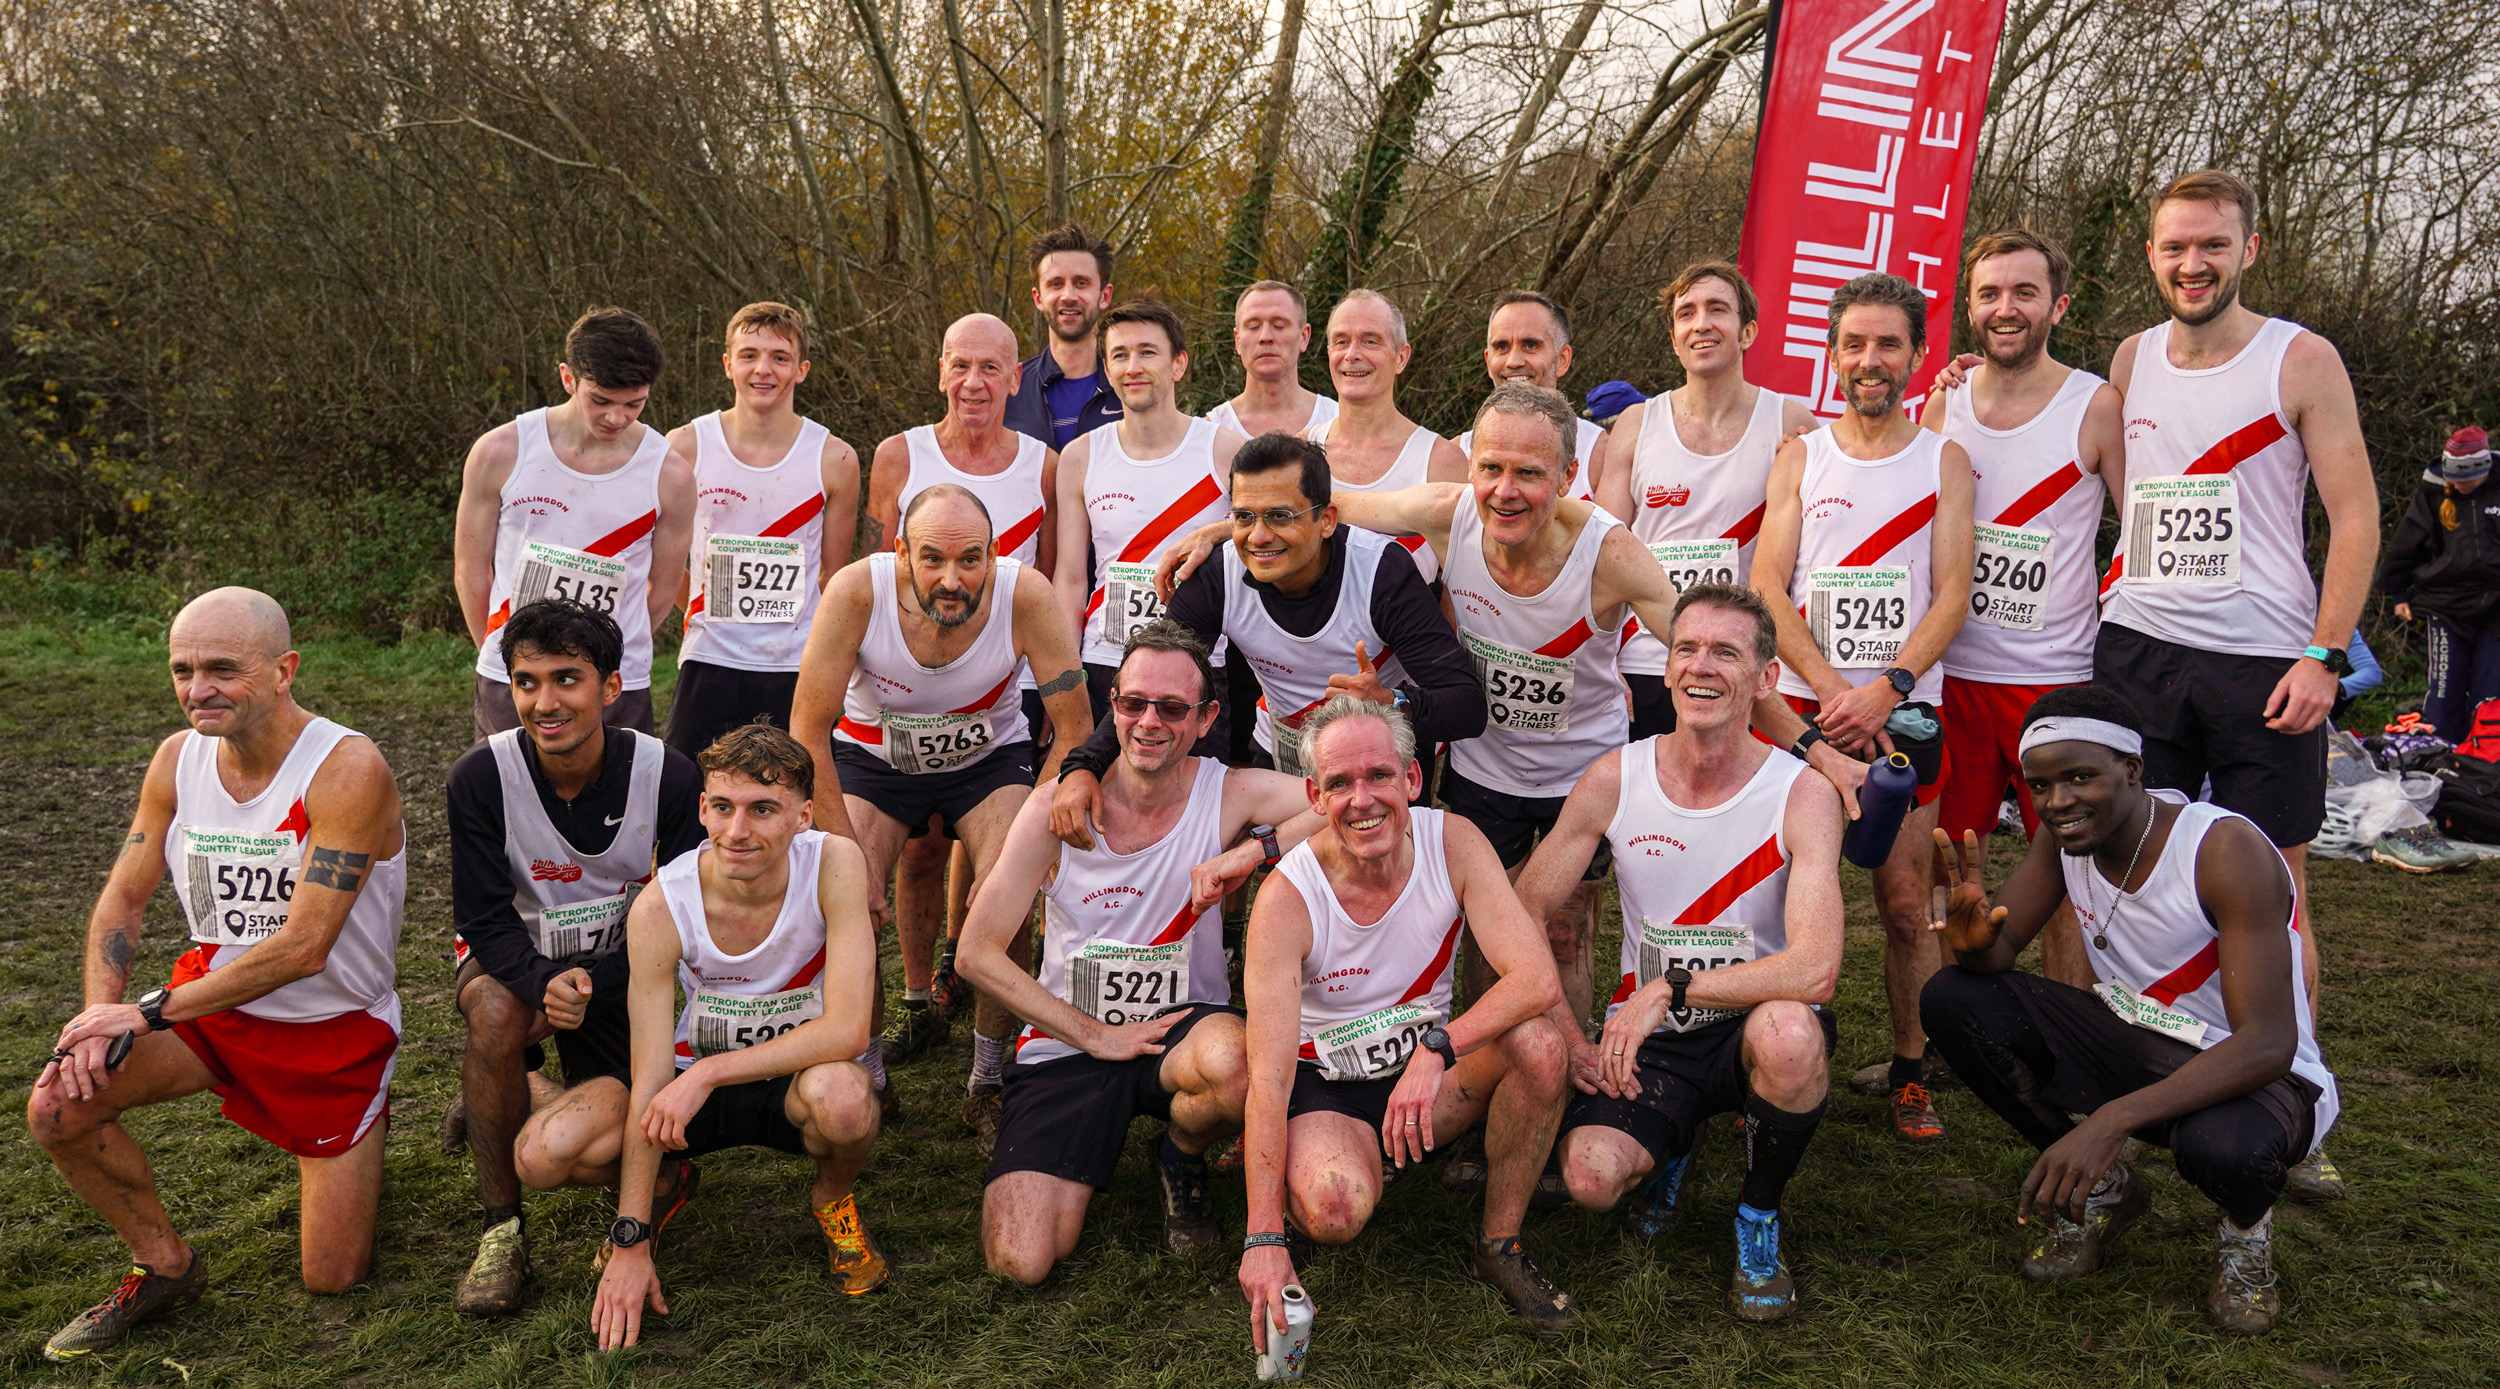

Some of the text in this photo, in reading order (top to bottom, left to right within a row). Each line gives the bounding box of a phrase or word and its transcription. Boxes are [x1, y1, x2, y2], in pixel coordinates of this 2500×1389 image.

[2134, 480, 2231, 492] METROPOLITAN CROSS
[698, 487, 748, 502] HILLINGDON
[1088, 492, 1136, 510] HILLINGDON
[2141, 489, 2220, 499] COUNTRY LEAGUE
[512, 496, 569, 512] HILLINGDON
[1804, 497, 1853, 518] HILLINGDON
[530, 508, 548, 516] A.C.
[1816, 510, 1832, 519] A.C.
[2156, 507, 2233, 542] 5235
[1974, 525, 2051, 544] OPOLITAN CROSS
[710, 538, 799, 550] METROPOLITAN CROSS
[1650, 543, 1732, 555] TROPOLITAN CROSS
[1974, 534, 2040, 551] NTRY LEAGUE
[529, 543, 626, 572] METROPOLITAN CROSS
[758, 548, 790, 556] LEAGUE
[1656, 552, 1722, 562] UNTRY LEAGUE
[536, 553, 615, 578] COUNTRY LEAGUE
[2178, 554, 2229, 566] START
[738, 562, 800, 591] 5227
[1108, 566, 1156, 575] METROPOLITA
[1811, 571, 1906, 580] METROPOLITAN CROSS
[1973, 552, 2047, 592] 5260
[2176, 567, 2226, 576] FITNESS
[1114, 574, 1146, 582] COUNTRY
[1816, 580, 1895, 588] COUNTRY LEAGUE
[554, 576, 619, 615] 5135
[1452, 588, 1502, 617] HILLINGDON
[757, 600, 795, 611] START
[1128, 589, 1166, 618] 52
[1466, 604, 1481, 616] A.C.
[1990, 599, 2037, 615] START
[755, 610, 794, 618] FITNESS
[1835, 597, 1905, 630] 5243
[1988, 610, 2032, 624] FITNESS
[1462, 632, 1568, 668] METROPOLITAN CROSS
[1858, 641, 1901, 652] START
[1471, 644, 1555, 674] COUNTRY LEAGUE
[1855, 652, 1898, 662] FITNESS
[2437, 626, 2449, 698] LACROSSE
[1490, 669, 1566, 705] 5236
[881, 713, 949, 724] METROPOLITAN
[1512, 709, 1559, 722] START
[892, 720, 933, 730] COUNTRY
[936, 716, 972, 729] LEAGUE
[1509, 719, 1556, 729] FITNESS
[919, 723, 990, 756] 5263
[254, 838, 291, 847] CROSS
[1628, 834, 1687, 852] HILLINGDON
[240, 846, 278, 856] LEAGUE
[1646, 848, 1664, 857] A.C.
[217, 865, 296, 902] 5226
[1082, 886, 1144, 905] HILLINGDON
[545, 899, 625, 920] METROPOLITAN
[1104, 900, 1123, 909] A.C.
[248, 914, 288, 927] STAR
[558, 911, 608, 927] COUNTRY
[246, 928, 281, 938] FITN
[1645, 933, 1734, 947] COUNTRY LEAGUE
[1710, 930, 1747, 939] CROSS
[1083, 950, 1172, 962] COUNTRY LEAGUE
[1152, 944, 1183, 954] CROSS
[1104, 970, 1178, 1004] 5221
[1328, 984, 1349, 993] A.C.
[697, 991, 815, 1009] METROPOLITAN CROSS
[708, 1002, 803, 1017] COUNTRY LEAGUE
[1127, 1010, 1163, 1022] STAR
[1319, 1008, 1393, 1041] METROPOLITAN
[2140, 1013, 2182, 1031] LEAGUE
[2161, 1011, 2199, 1027] CROSS
[735, 1018, 813, 1049] 52
[1331, 1010, 1421, 1048] COUNTRY LEAGUE
